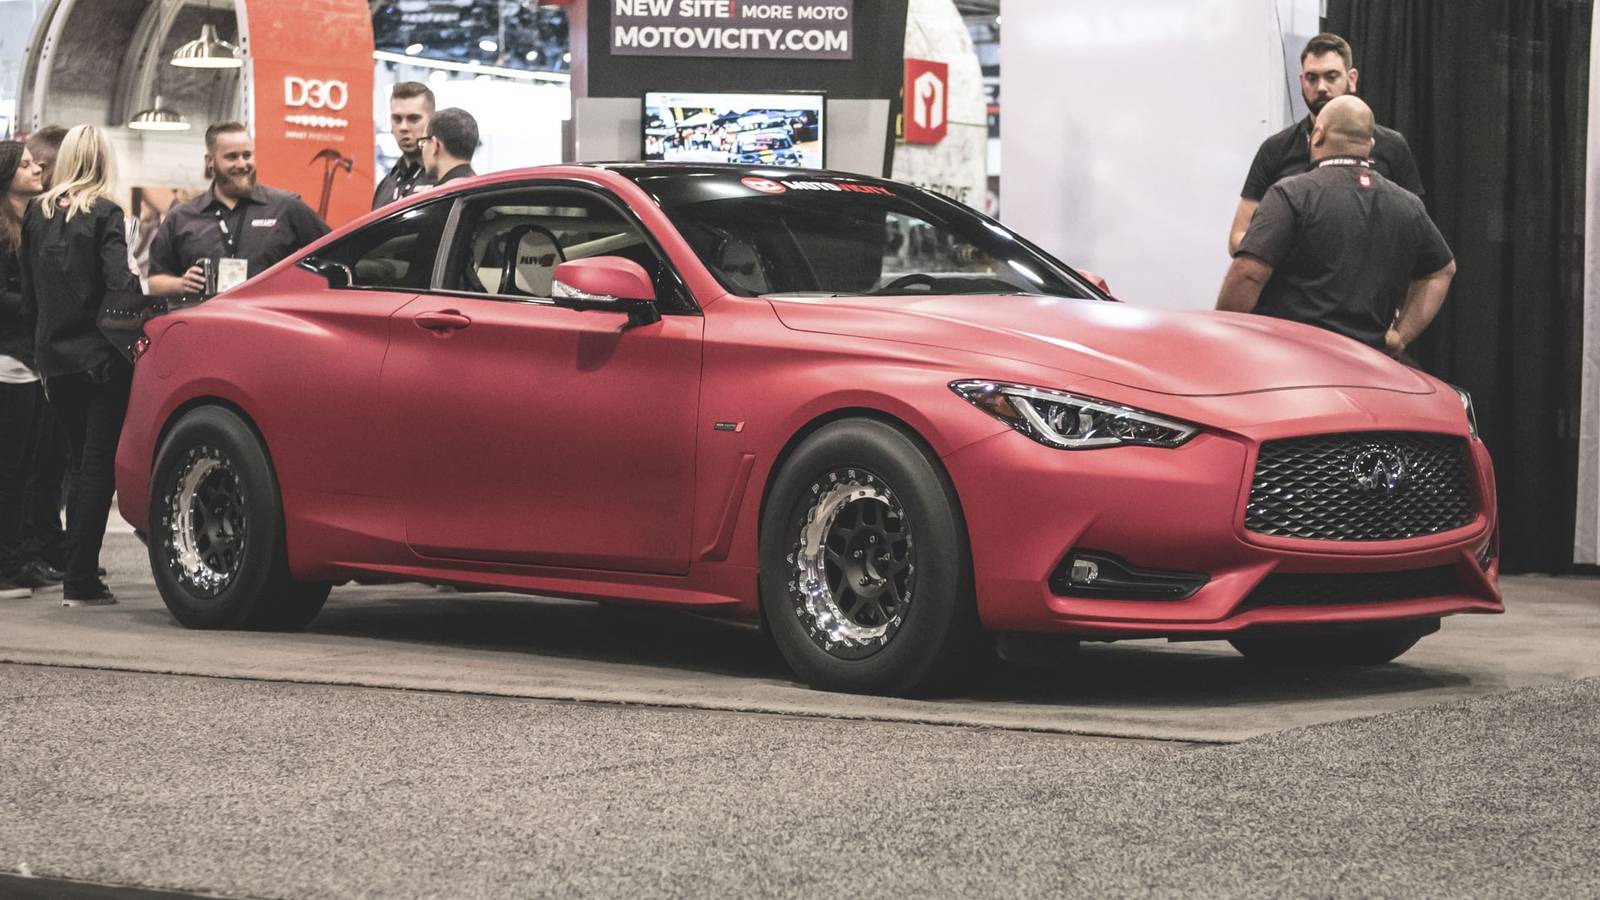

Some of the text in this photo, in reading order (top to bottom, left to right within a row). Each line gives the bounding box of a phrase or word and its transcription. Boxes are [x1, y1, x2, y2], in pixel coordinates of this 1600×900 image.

[616, 0, 849, 20] NEW SITE! MORE MOTO
[614, 26, 848, 51] MOTOVICITY.COM
